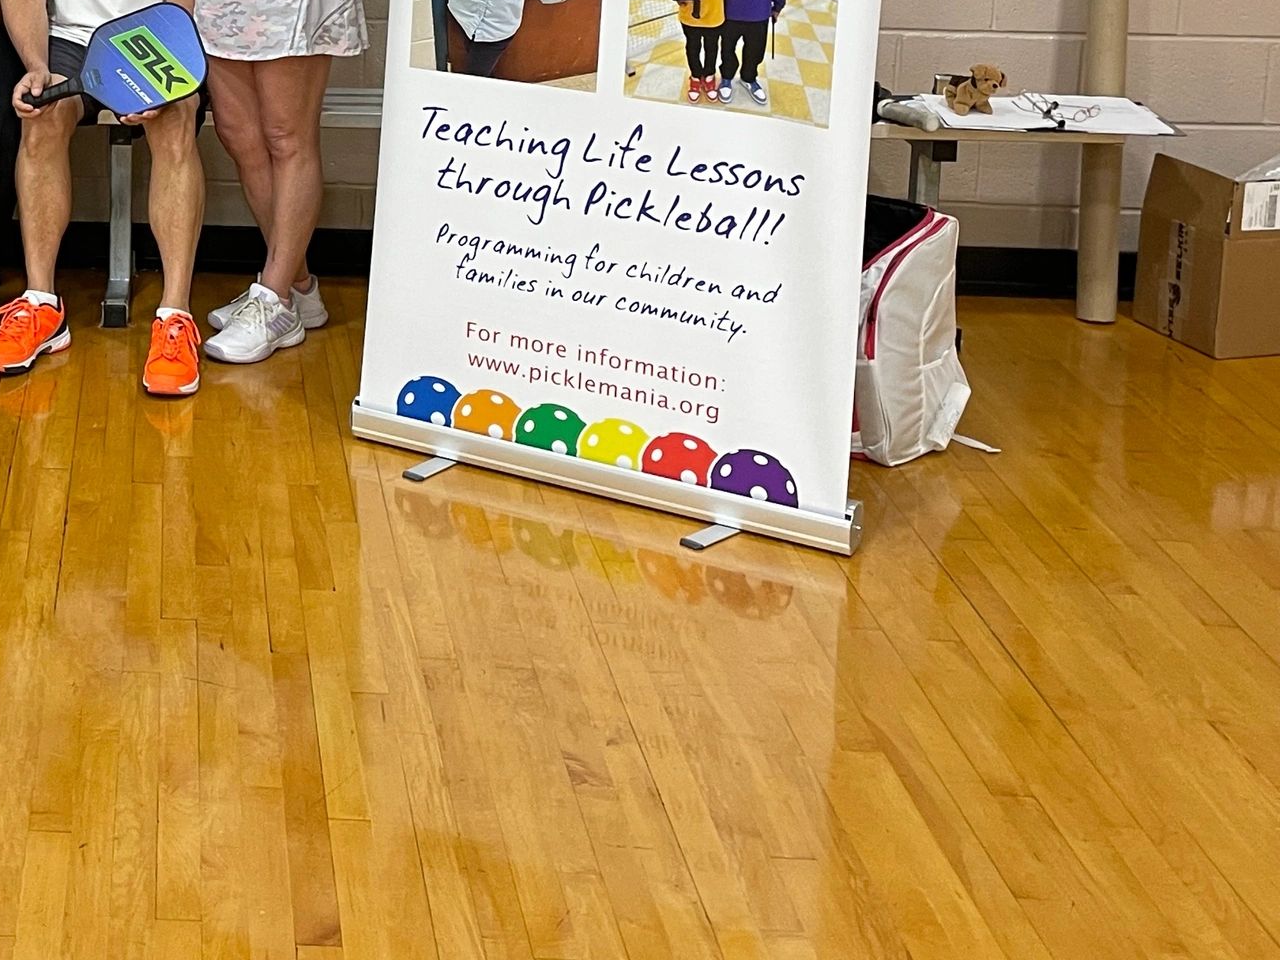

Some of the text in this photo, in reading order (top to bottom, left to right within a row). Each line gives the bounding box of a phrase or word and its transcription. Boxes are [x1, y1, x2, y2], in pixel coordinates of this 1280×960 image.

[120, 33, 190, 94] SLK
[422, 106, 806, 197] Teaching Life Lessons
[437, 156, 786, 246] through Pickleball!
[436, 223, 783, 303] Programming for children and
[456, 252, 747, 344] families in our community.
[465, 321, 727, 393] For more information:
[467, 352, 720, 424] www.picklemania.org
